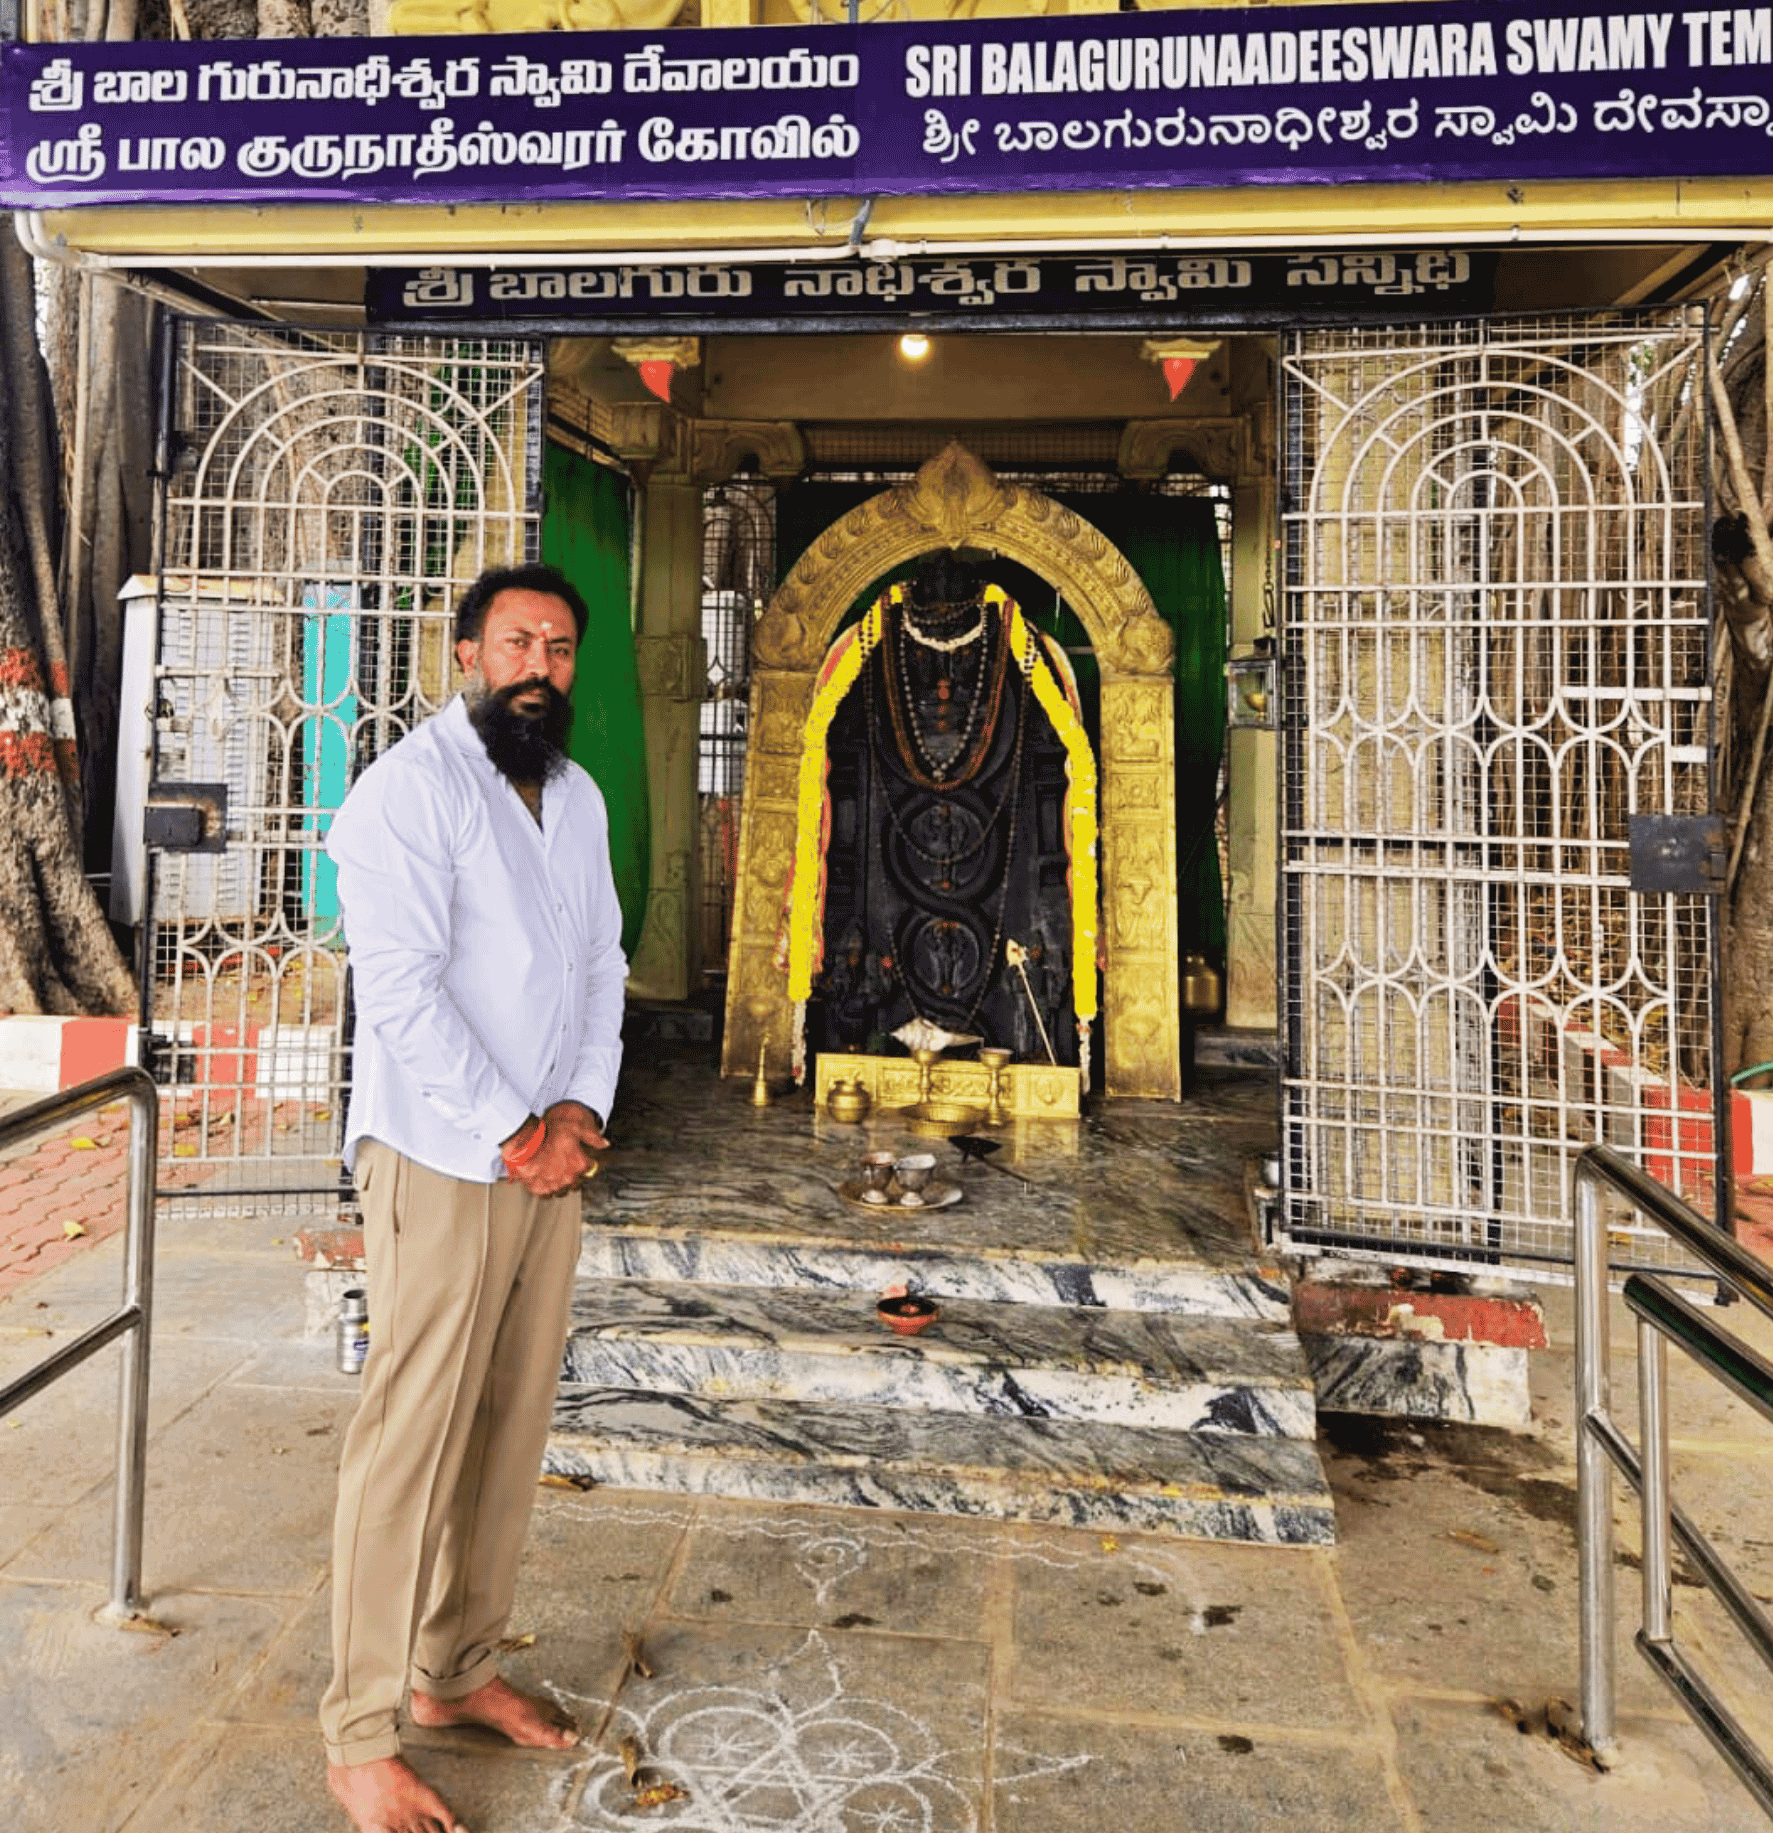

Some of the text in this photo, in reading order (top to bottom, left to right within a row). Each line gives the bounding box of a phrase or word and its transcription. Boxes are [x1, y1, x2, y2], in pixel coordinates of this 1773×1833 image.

[29, 58, 84, 111] శ్రీ
[93, 70, 188, 103] బాల
[489, 55, 612, 108] స్వామి
[623, 44, 860, 93] దేవాలయం
[905, 8, 1772, 98] SRI BALAGURUNAADEESWARA SWAMY TEM
[118, 137, 226, 171] பால
[236, 117, 627, 181] குருநாதீஸ்வரர்
[637, 114, 861, 163] கோவில்
[921, 108, 981, 163] ಶ್ರೀ
[993, 97, 1419, 151] ಬಾಲಗುರುನಾಧೀಶ್ವರ
[1434, 90, 1579, 146] ಸ್ವಾಮಿ
[1074, 258, 1253, 302] స్వామి
